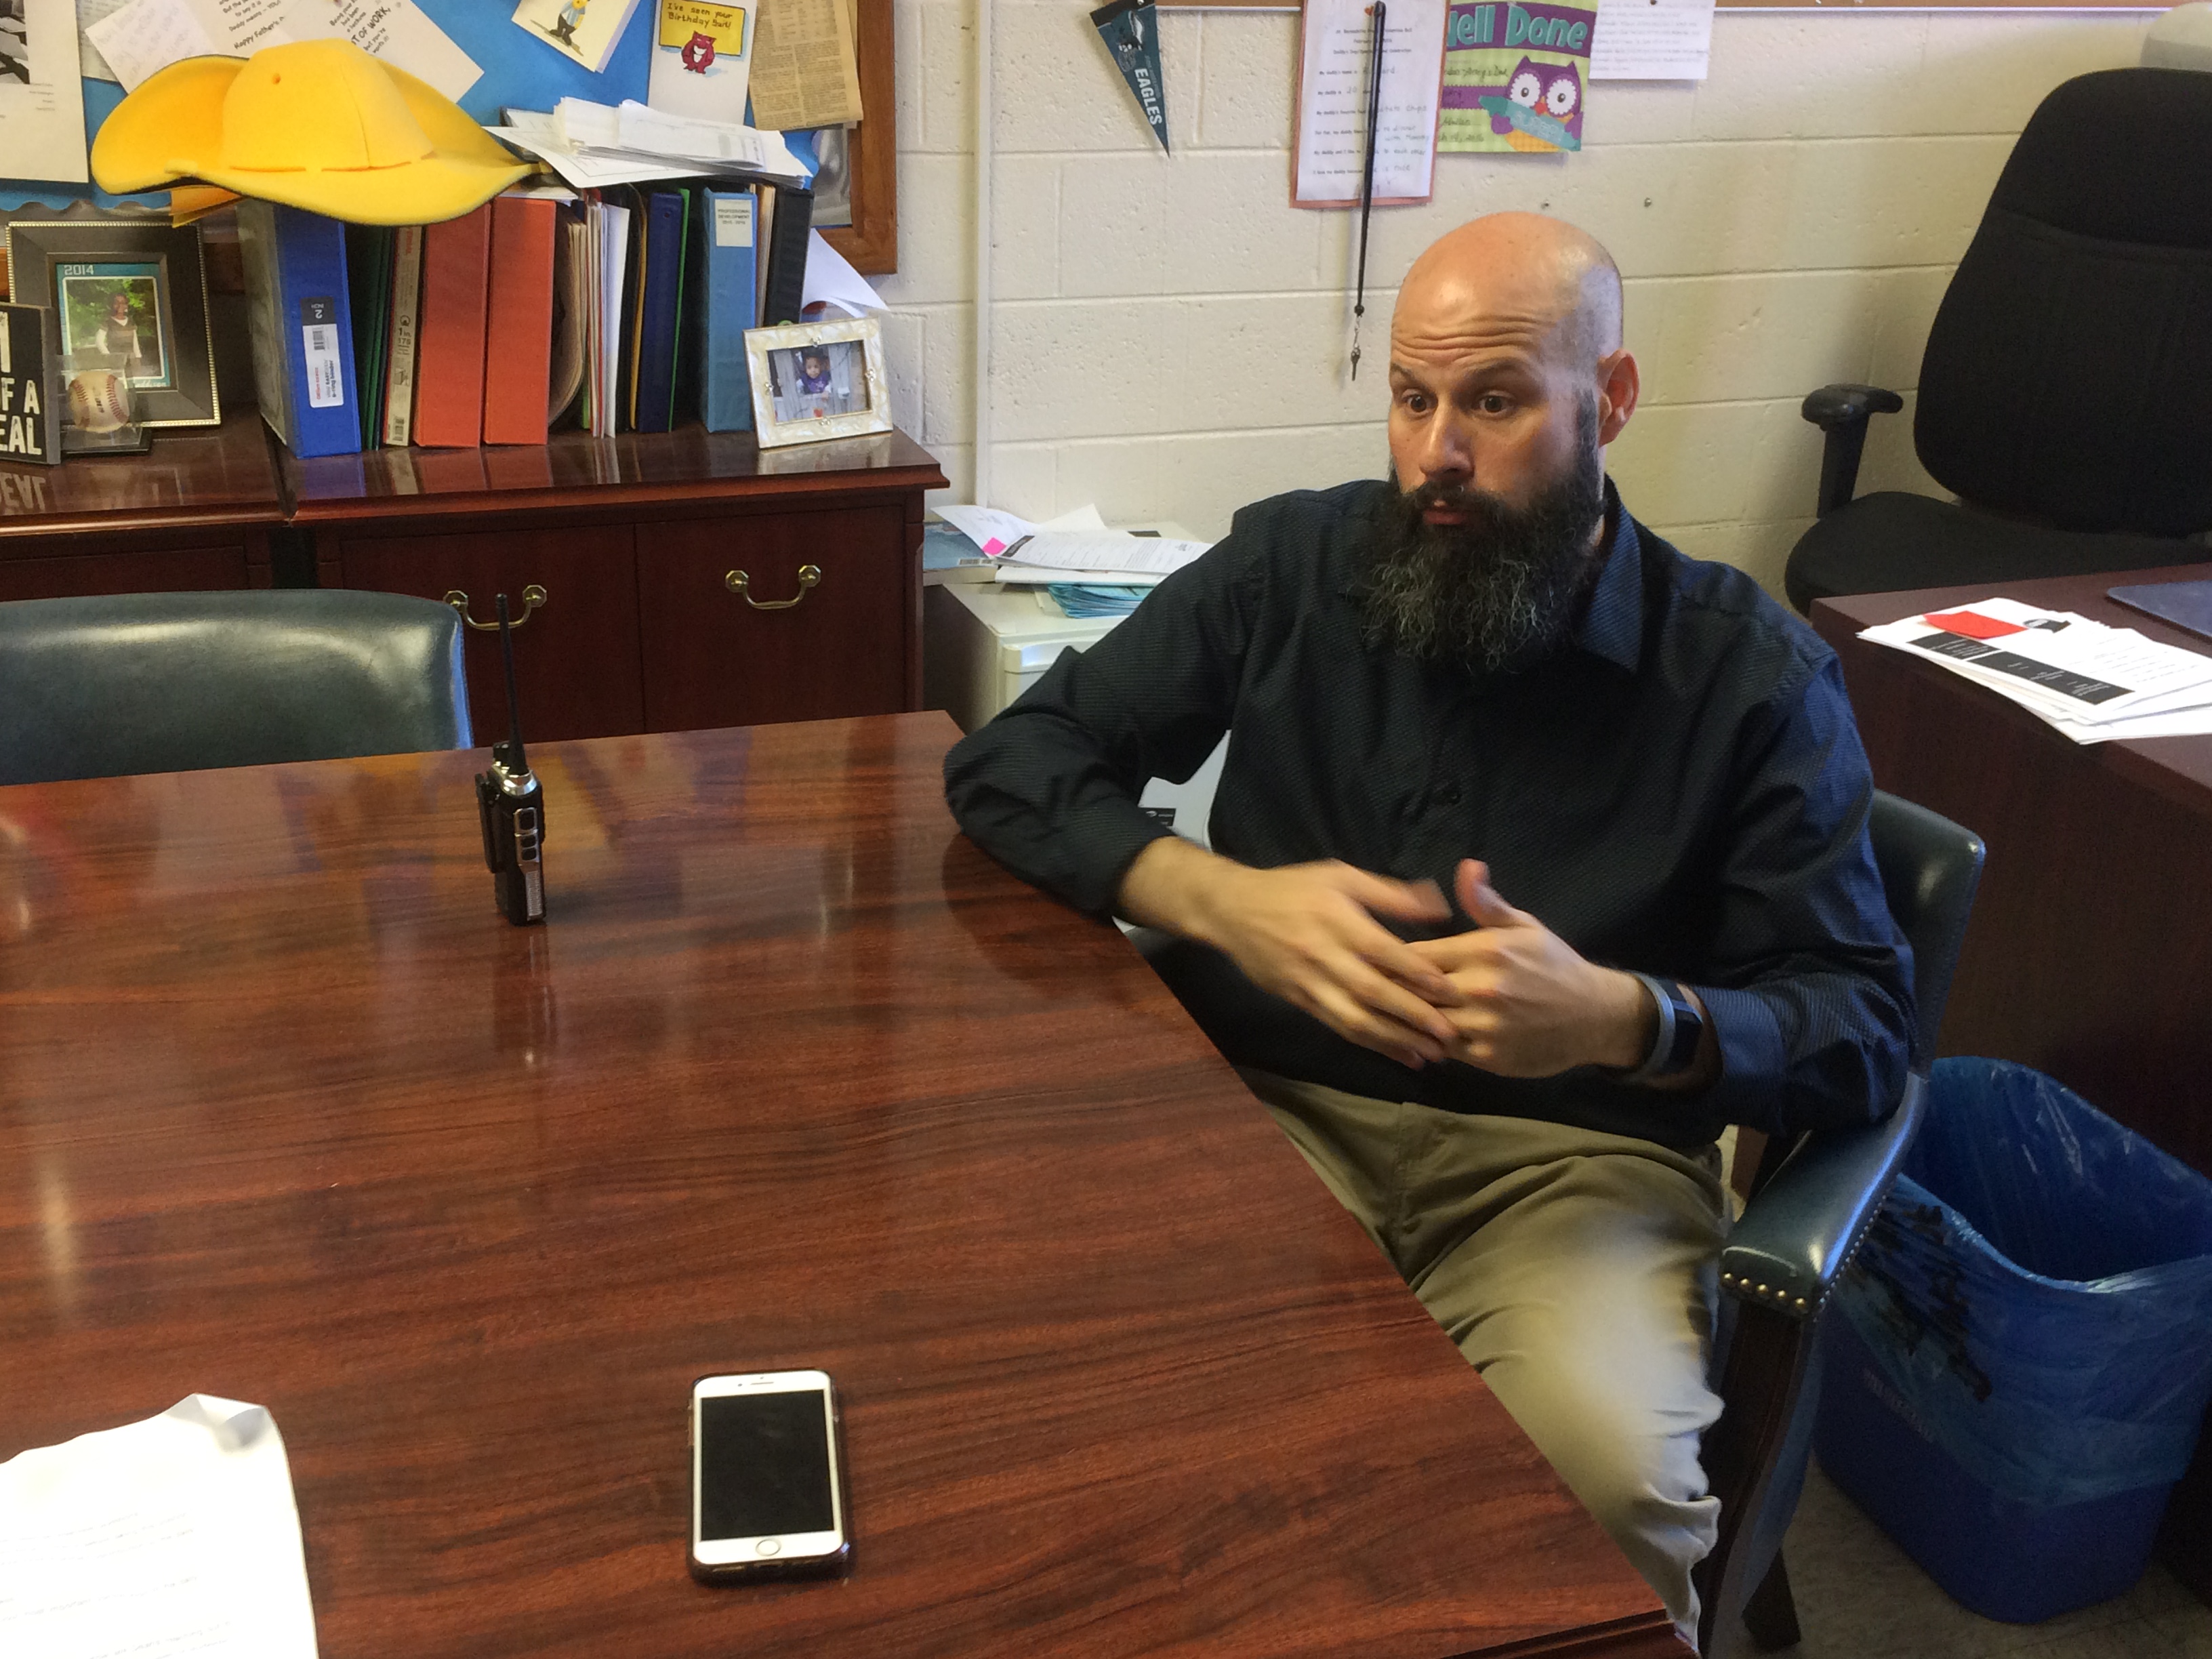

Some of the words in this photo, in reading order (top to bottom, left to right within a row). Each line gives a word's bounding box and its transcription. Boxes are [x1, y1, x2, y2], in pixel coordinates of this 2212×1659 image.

[667, 2, 684, 12] I've
[691, 6, 710, 15] seen
[329, 12, 344, 26] Being
[358, 26, 368, 39] OF
[367, 6, 392, 29] WORK,
[668, 12, 710, 28] Birthday
[1504, 5, 1589, 50] Done
[234, 35, 253, 49] Happy
[363, 41, 373, 52] but
[1134, 68, 1162, 125] EAGLES
[64, 264, 94, 275] 2014
[314, 309, 323, 319] 2
[24, 380, 40, 415] A
